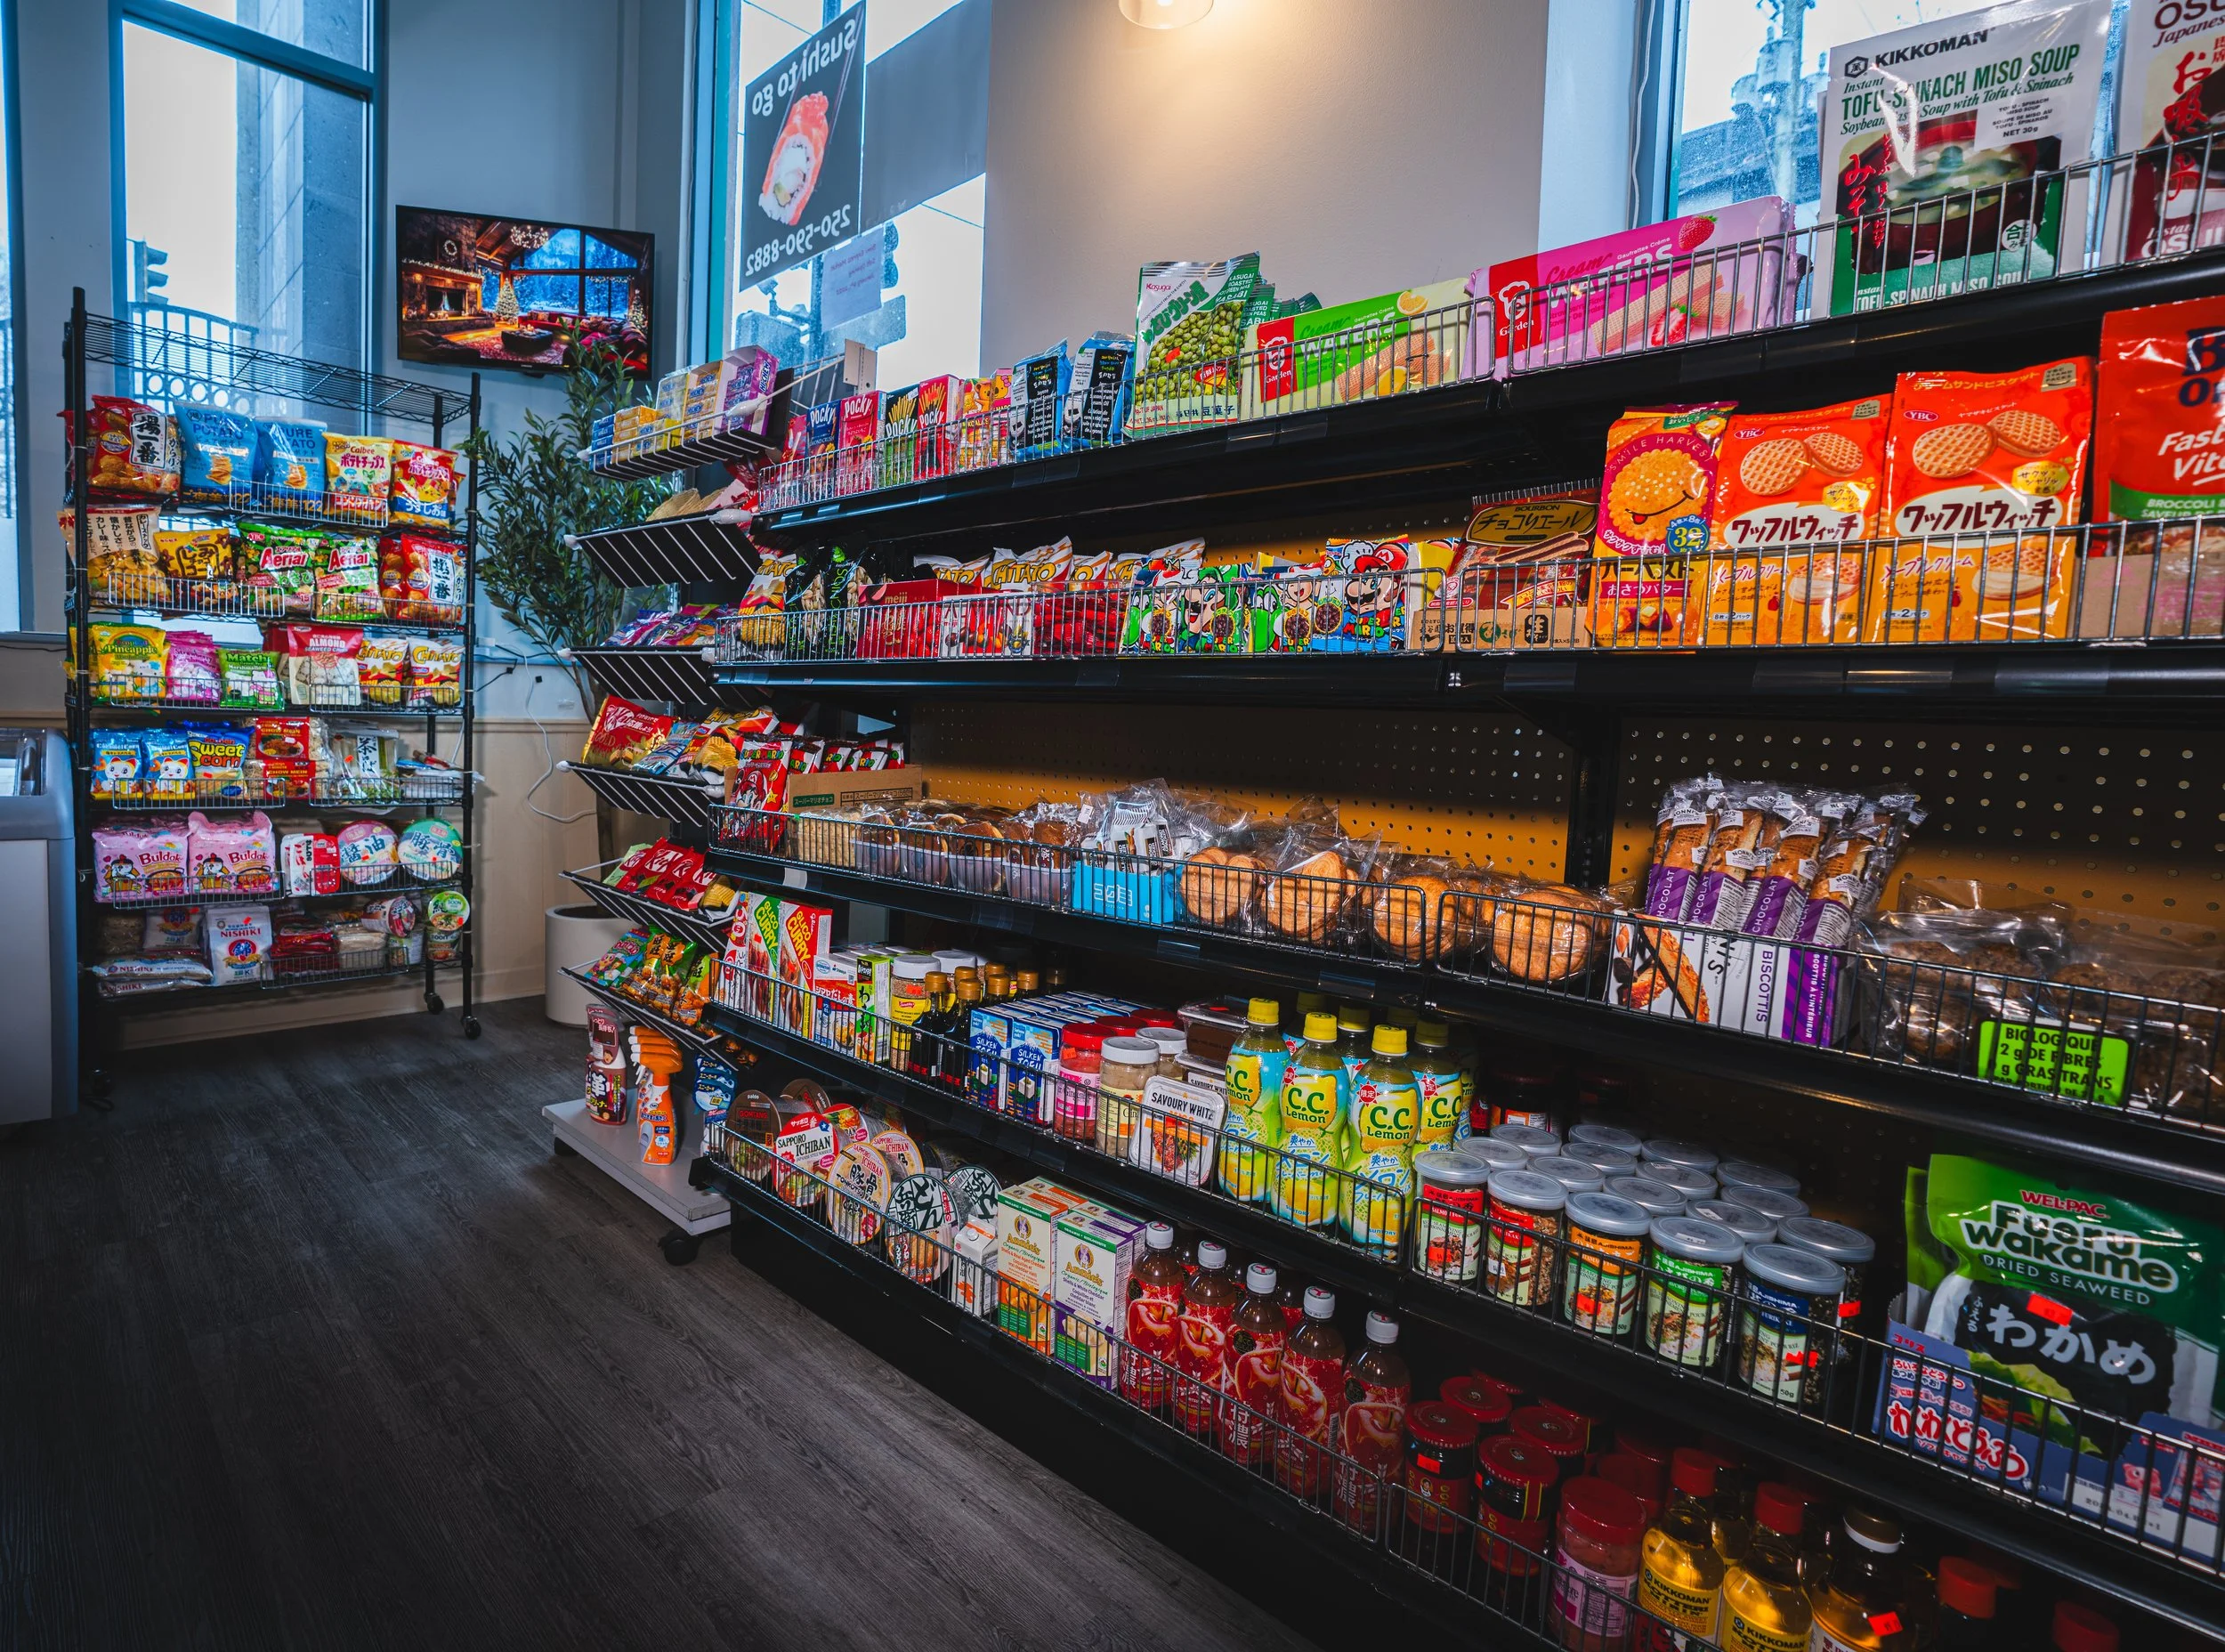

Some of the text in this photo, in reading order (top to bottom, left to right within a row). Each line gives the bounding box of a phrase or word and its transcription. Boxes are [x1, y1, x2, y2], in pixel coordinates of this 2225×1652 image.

[1874, 28, 1989, 68] KIKKOMAN
[1974, 44, 2081, 86] MISO SOUP
[1843, 77, 1884, 94] Instant
[1841, 117, 1886, 136] Soybean
[1920, 101, 1951, 121] Soup
[1953, 95, 1978, 111] with
[1981, 88, 2008, 105] Tofu
[2010, 86, 2022, 97] &
[2024, 72, 2075, 94] Spinach
[2024, 104, 2041, 112] SOUP
[1993, 117, 2015, 126] SOUPE
[2026, 110, 2042, 118] MISO
[2003, 126, 2039, 138] NET 30g
[1616, 245, 1649, 261] Gaufrettes
[1545, 251, 1614, 283] Cream
[1545, 242, 1674, 309] WAFERS
[1145, 282, 1172, 292] Kasugai
[1299, 316, 1351, 340] Cream
[1299, 311, 1398, 360] WAFERS
[1499, 320, 1535, 337] Garden
[758, 360, 771, 393] HI-CHEW
[1266, 370, 1291, 385] Garden
[1202, 405, 1235, 417] 豆菓子
[1906, 410, 1936, 420] YBC
[1667, 416, 1702, 425] おいしさ
[134, 414, 161, 465] 揚一番
[1737, 429, 1762, 439] YBC
[350, 445, 376, 456] Calbee
[1609, 440, 1647, 472] SMILE
[340, 452, 386, 470] ポテトチップス
[1514, 503, 1561, 513] BOURBON
[2147, 498, 2217, 510] BROCCOLI
[1902, 498, 2056, 534] ワッフルウィッチ
[248, 532, 265, 541] YBC
[1673, 526, 1703, 547] 32
[1731, 513, 1859, 545] ワッフルウィッチ
[260, 547, 309, 570] Aerial
[328, 548, 368, 572] Aerial
[991, 559, 1056, 589] CHITATO
[885, 591, 908, 603] meiji
[1606, 582, 1684, 597] おさつバター
[1348, 613, 1380, 626] SUPER
[1342, 623, 1385, 638] MARIO
[106, 644, 158, 655] Pineapple
[309, 637, 346, 648] ALMOND
[412, 645, 460, 664] CHITATO
[188, 741, 246, 767] Sweet
[200, 755, 242, 769] corn
[740, 749, 763, 760] SUPER
[139, 851, 182, 867] Buldak
[228, 850, 270, 864] Buldak
[763, 900, 780, 930] GLICO
[1752, 879, 1778, 934] CHOCOLAT
[220, 927, 262, 938] NISHIKI
[756, 910, 779, 950] CURRY
[796, 911, 812, 942] GLICO
[787, 920, 812, 962] CURRY
[1756, 949, 1773, 1023] BISCOTTIS
[975, 1036, 999, 1050] SILKEN
[1018, 1048, 1042, 1062] SILKEN
[2000, 1042, 2009, 1056] 2
[2028, 1047, 2045, 1062] DE
[591, 1070, 607, 1097] 革
[2059, 1070, 2113, 1089] TRANS
[1287, 1087, 1331, 1114] C.C.
[1358, 1089, 1377, 1100] 限定
[1151, 1091, 1188, 1112] SAVOURY
[1188, 1103, 1214, 1121] WHITE
[1285, 1105, 1326, 1124] Lemon
[739, 1109, 768, 1121] GOMTANG
[790, 1116, 809, 1128] サッポロ
[1370, 1105, 1413, 1131] C.C.
[777, 1134, 806, 1148] SAPPORO
[873, 1137, 893, 1145] SAPPORO
[1290, 1134, 1315, 1146] 爽やか
[1366, 1125, 1410, 1140] Lemon
[795, 1135, 831, 1157] ICHIBAN
[854, 1143, 871, 1158] SAPPORO
[885, 1142, 910, 1153] ICHIBAN
[861, 1156, 884, 1178] ICHIBAN
[1371, 1154, 1398, 1167] 爽やか
[849, 1163, 878, 1195] 豚骨
[1994, 1203, 2139, 1257] Fueru
[1007, 1232, 1041, 1256] Annie's
[1962, 1220, 2175, 1290] wakame
[1065, 1260, 1104, 1288] Annie's
[1675, 1263, 1714, 1277] AJISHIMA
[1983, 1254, 2151, 1306] DRIED SEAWEED
[1756, 1292, 1798, 1308] AJISHIMA
[1617, 1323, 1628, 1332] 50g
[1986, 1303, 2157, 1385] わかめ
[1780, 1389, 1794, 1399] 50g
[1654, 1576, 1711, 1605] KIKKOMAN
[1746, 1625, 1804, 1650] KIKKOMAN
